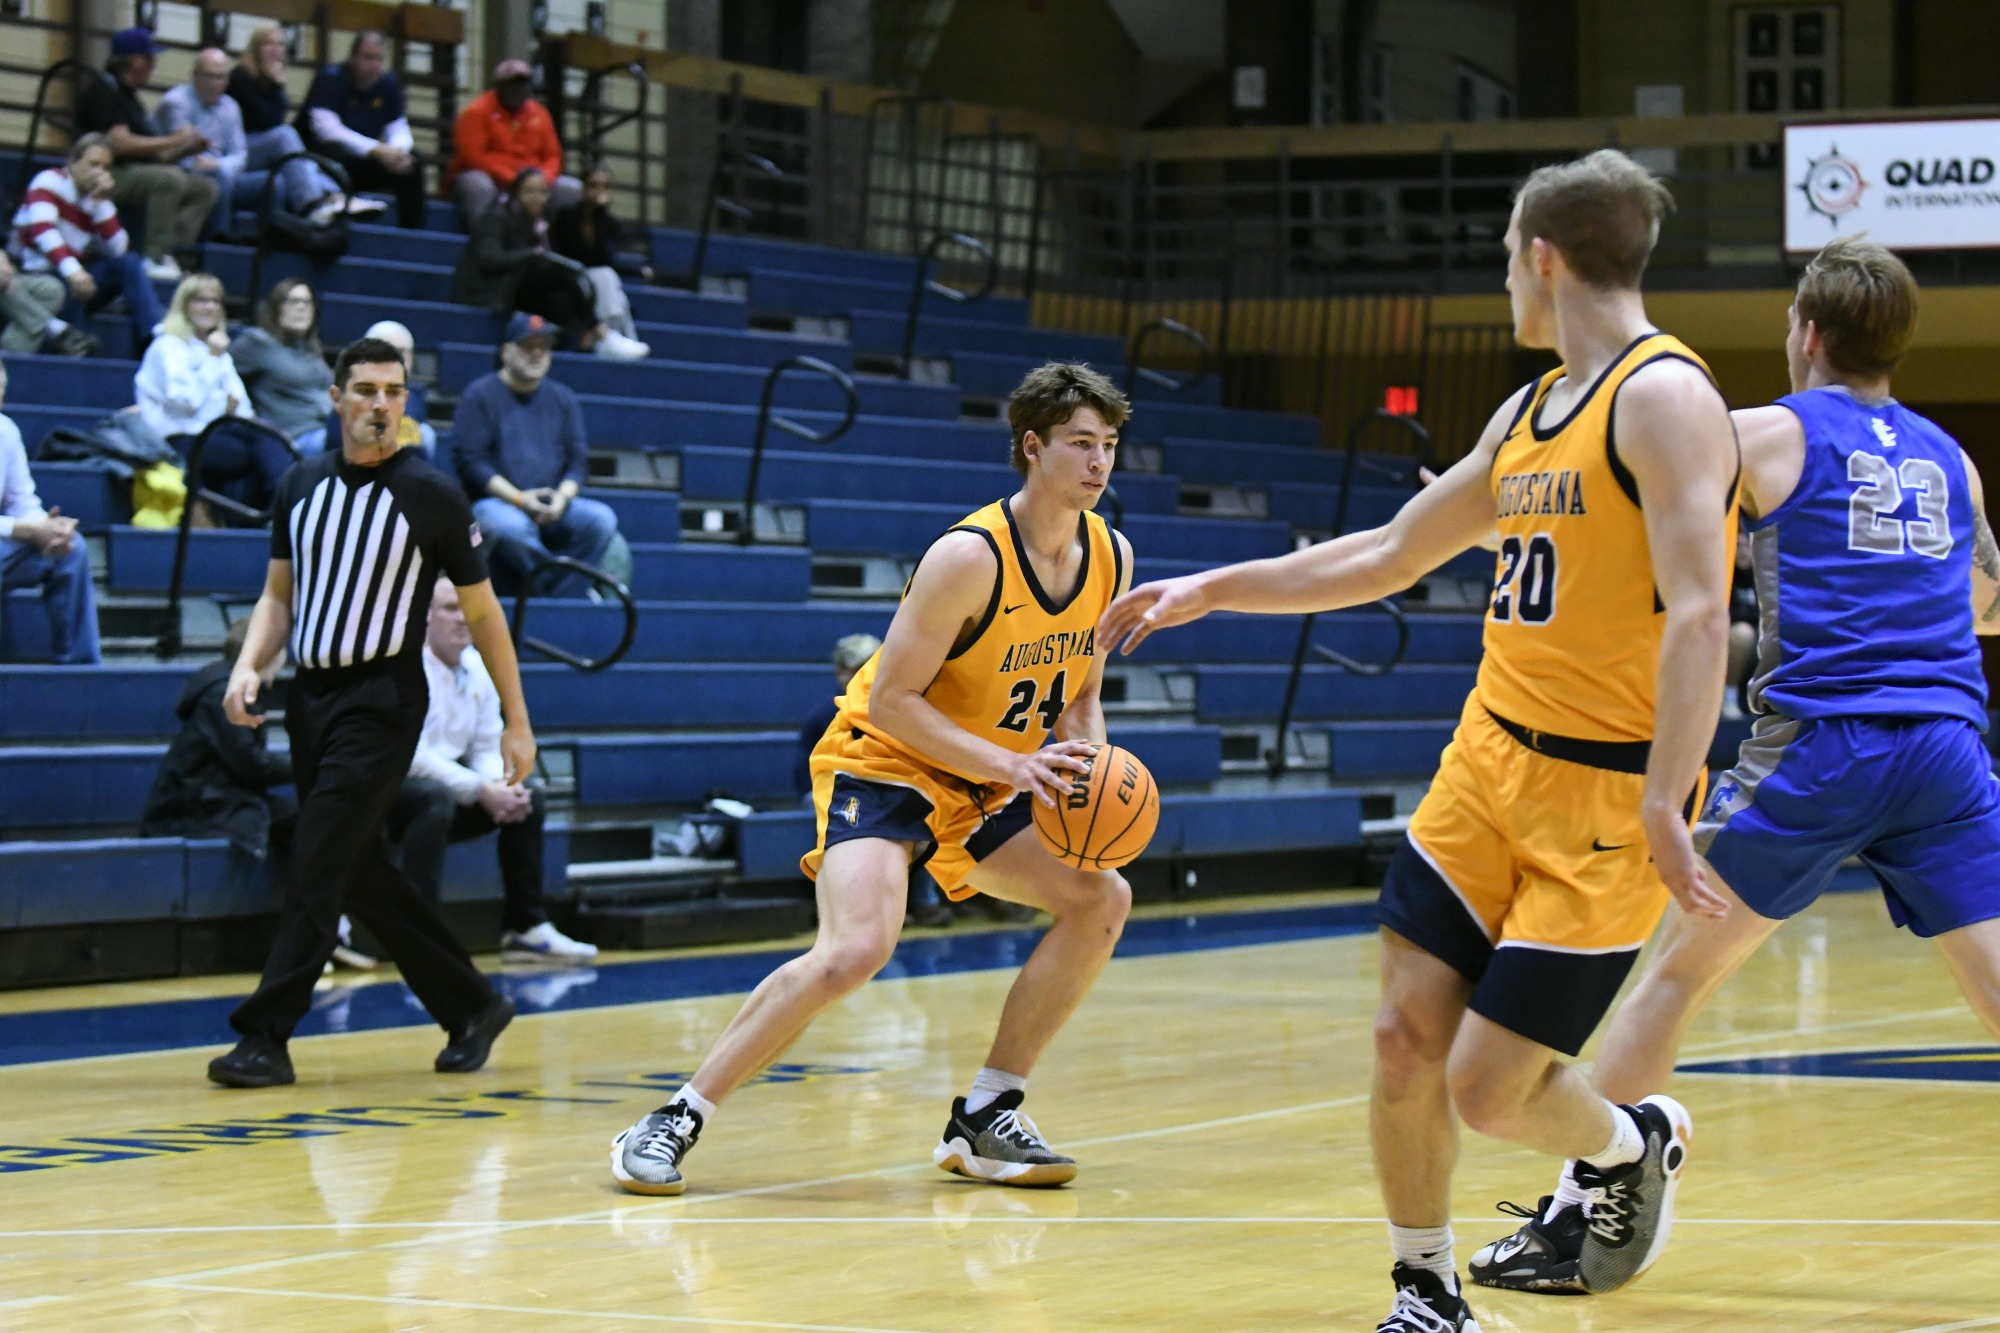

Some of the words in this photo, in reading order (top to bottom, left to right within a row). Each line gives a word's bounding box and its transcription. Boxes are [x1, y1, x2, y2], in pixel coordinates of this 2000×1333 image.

[1885, 157, 1996, 188] QUAD
[1497, 471, 1587, 518] UGUSTANA
[1847, 449, 1954, 560] 23
[1490, 532, 1558, 626] 20
[996, 667, 1068, 733] 24
[0, 1107, 507, 1173] CARVE
